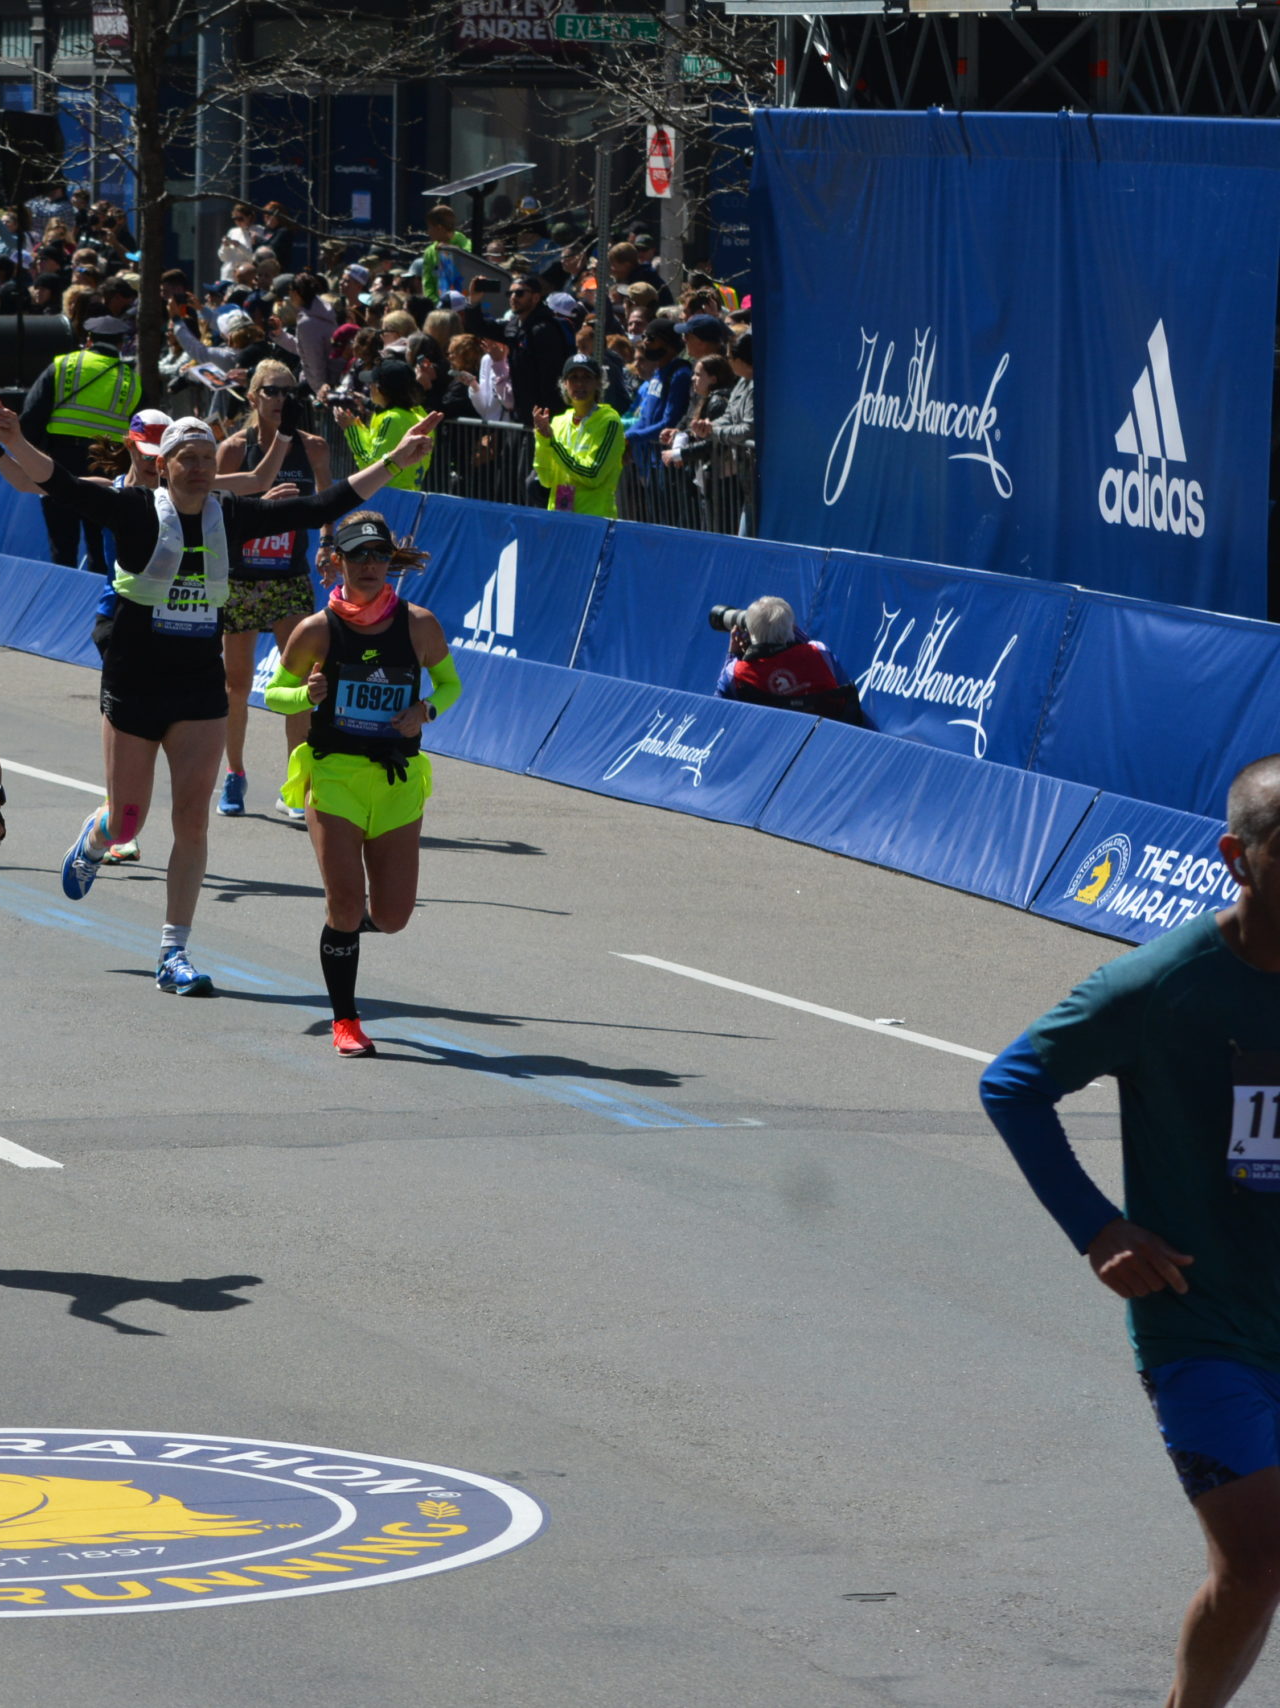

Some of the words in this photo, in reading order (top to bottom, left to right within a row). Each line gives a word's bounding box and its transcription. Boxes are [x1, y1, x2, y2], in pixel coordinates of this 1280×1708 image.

[1098, 454, 1205, 538] adidas
[345, 683, 405, 713] 16920
[1135, 844, 1180, 883] THE
[1106, 883, 1220, 929] MARATH
[56, 1546, 167, 1561] 1897
